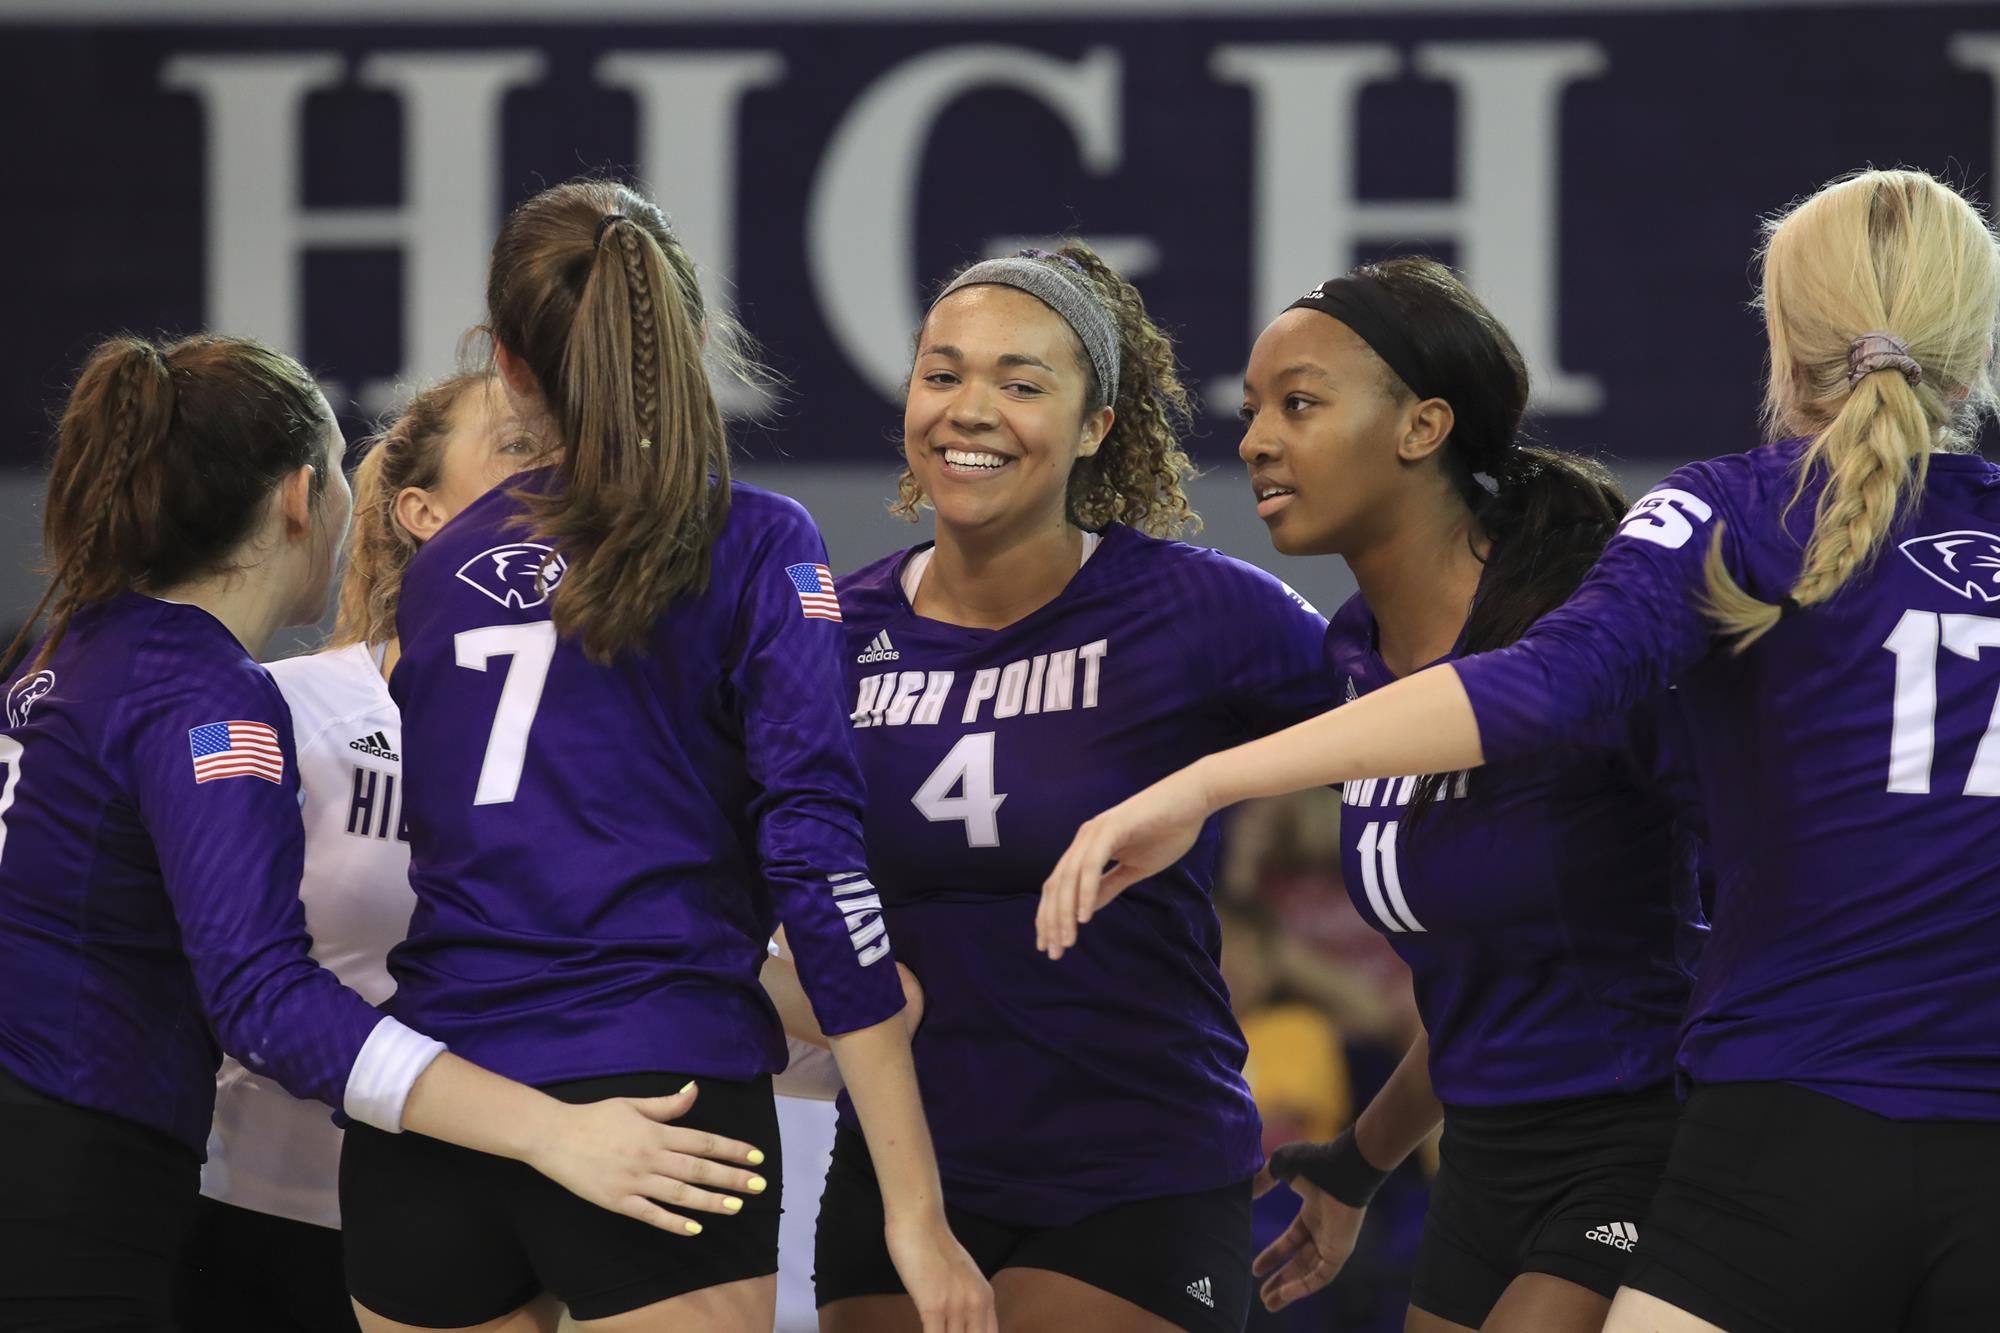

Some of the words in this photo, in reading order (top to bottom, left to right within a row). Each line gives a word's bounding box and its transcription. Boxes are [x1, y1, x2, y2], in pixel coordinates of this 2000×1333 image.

[163, 42, 1604, 415] HIGH
[850, 671, 955, 728] HIGH
[961, 639, 1108, 724] POINT
[857, 648, 900, 664] adidas
[454, 620, 557, 805] 7
[1882, 609, 2000, 797] 17
[349, 741, 399, 762] adidas
[910, 731, 1008, 848] 4
[344, 764, 409, 843] HI
[1356, 821, 1428, 932] 11
[1585, 1230, 1635, 1253] adid
[1186, 1285, 1214, 1308] adidas
